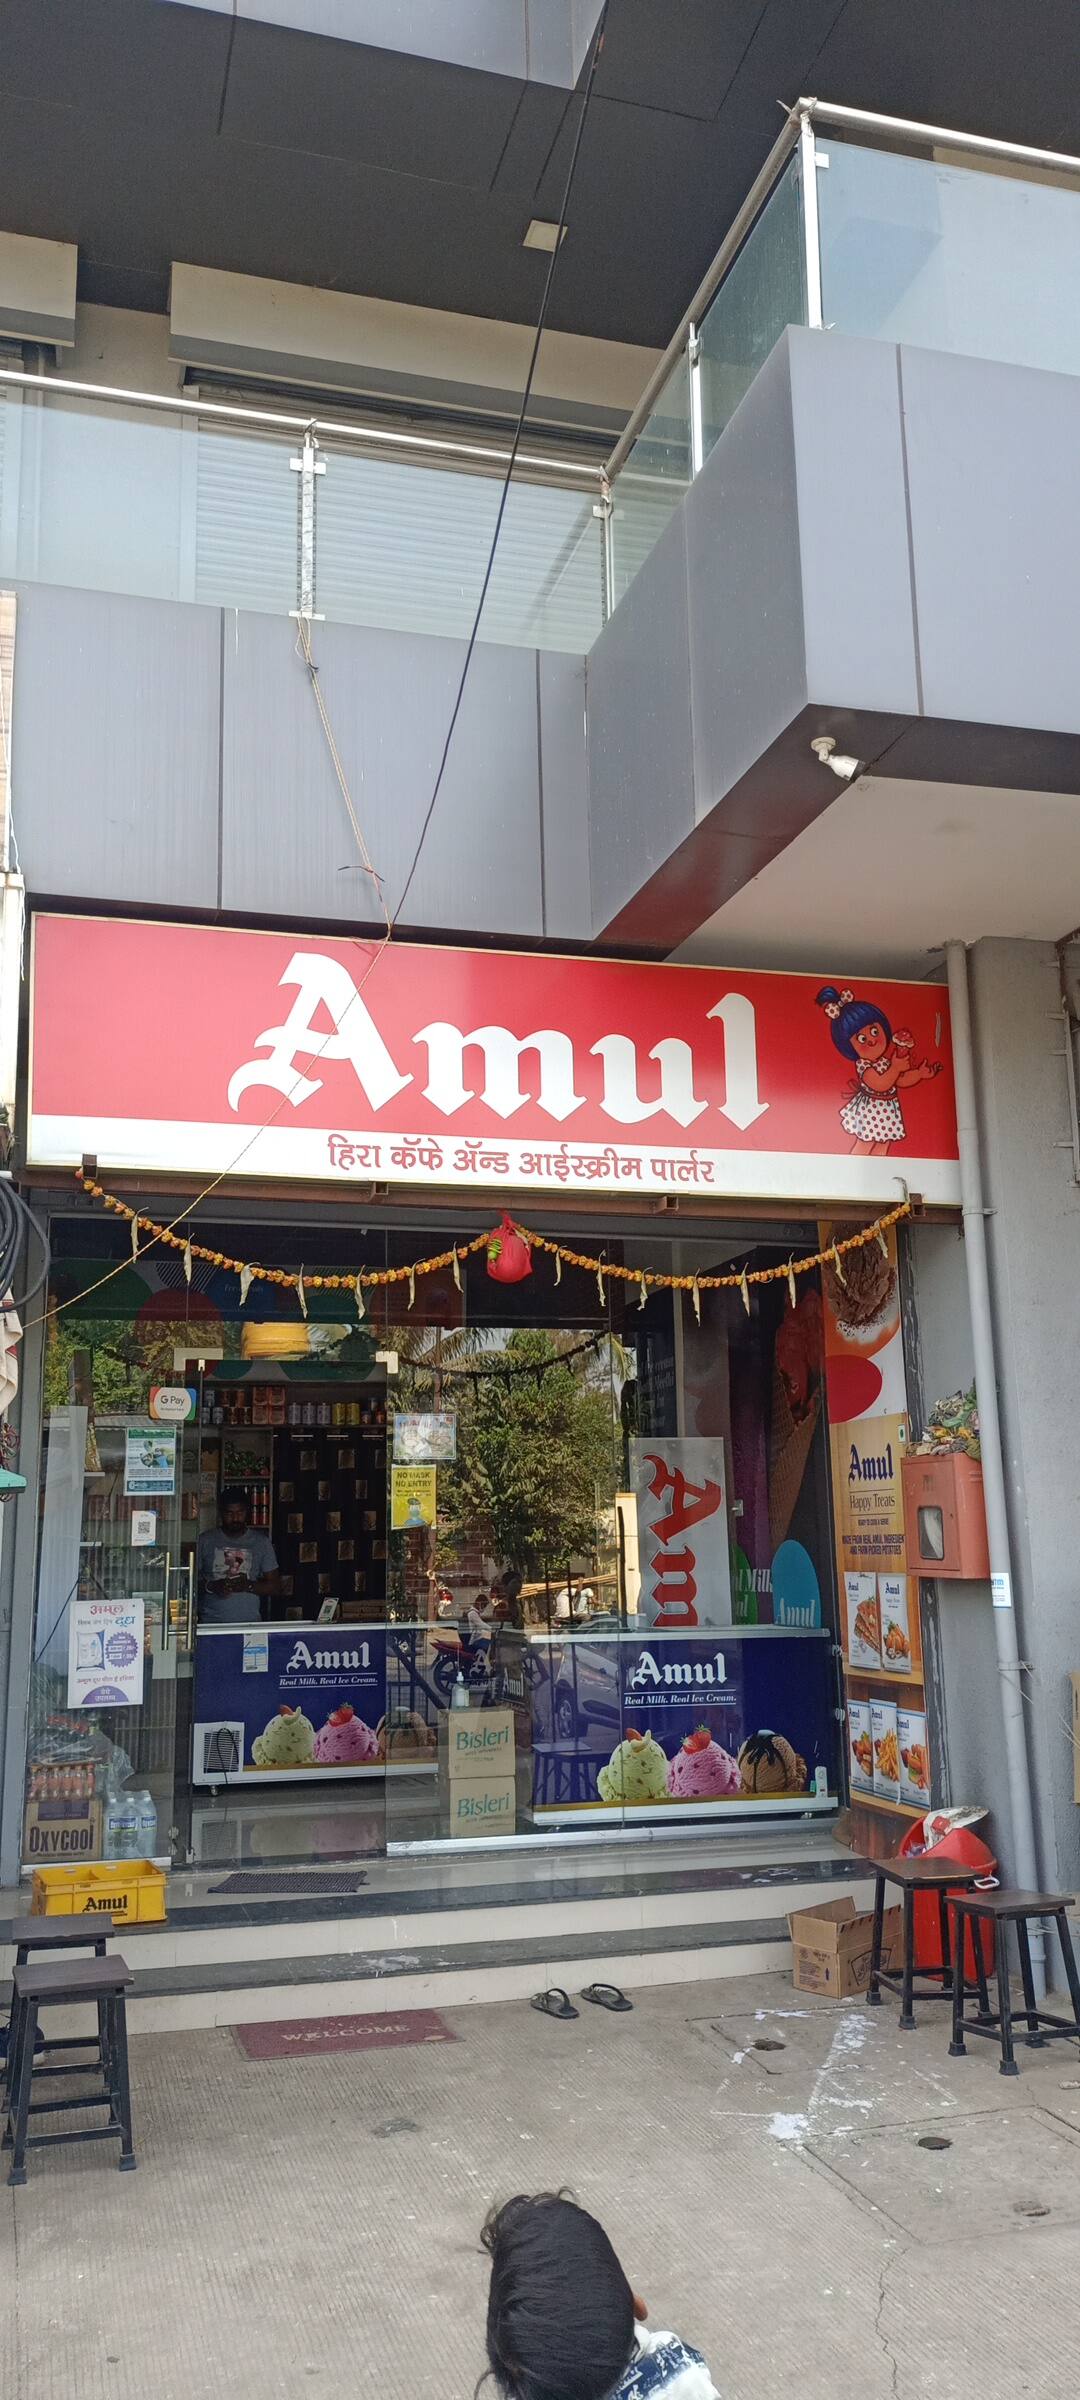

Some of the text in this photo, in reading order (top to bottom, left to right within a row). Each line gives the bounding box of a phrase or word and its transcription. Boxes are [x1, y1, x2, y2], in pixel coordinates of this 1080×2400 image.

[228, 952, 770, 1131] Amul
[328, 1134, 381, 1170] हिरा
[390, 1137, 443, 1171] कॅफे
[518, 1144, 642, 1182] आईस्क्रीम
[650, 1149, 715, 1183] पार्लर
[170, 1395, 185, 1406] Pay
[848, 1443, 894, 1486] Amul
[395, 1480, 432, 1488] NO ENTRY
[397, 1471, 408, 1479] NO
[849, 1493, 896, 1512] Happy Treats
[642, 1454, 722, 1627] Am
[885, 1582, 900, 1595] Amul
[286, 1641, 371, 1674] Amul
[631, 1651, 727, 1690] Amul
[280, 1675, 378, 1686] Real Milk. Real Ice Cream.
[625, 1693, 737, 1705] Real Milk. Real Ice Cream.
[456, 1726, 509, 1751] Bisleri
[457, 1792, 510, 1818] Bisleri
[82, 1894, 128, 1913] Amul
[281, 2024, 411, 2041] WELCOME
